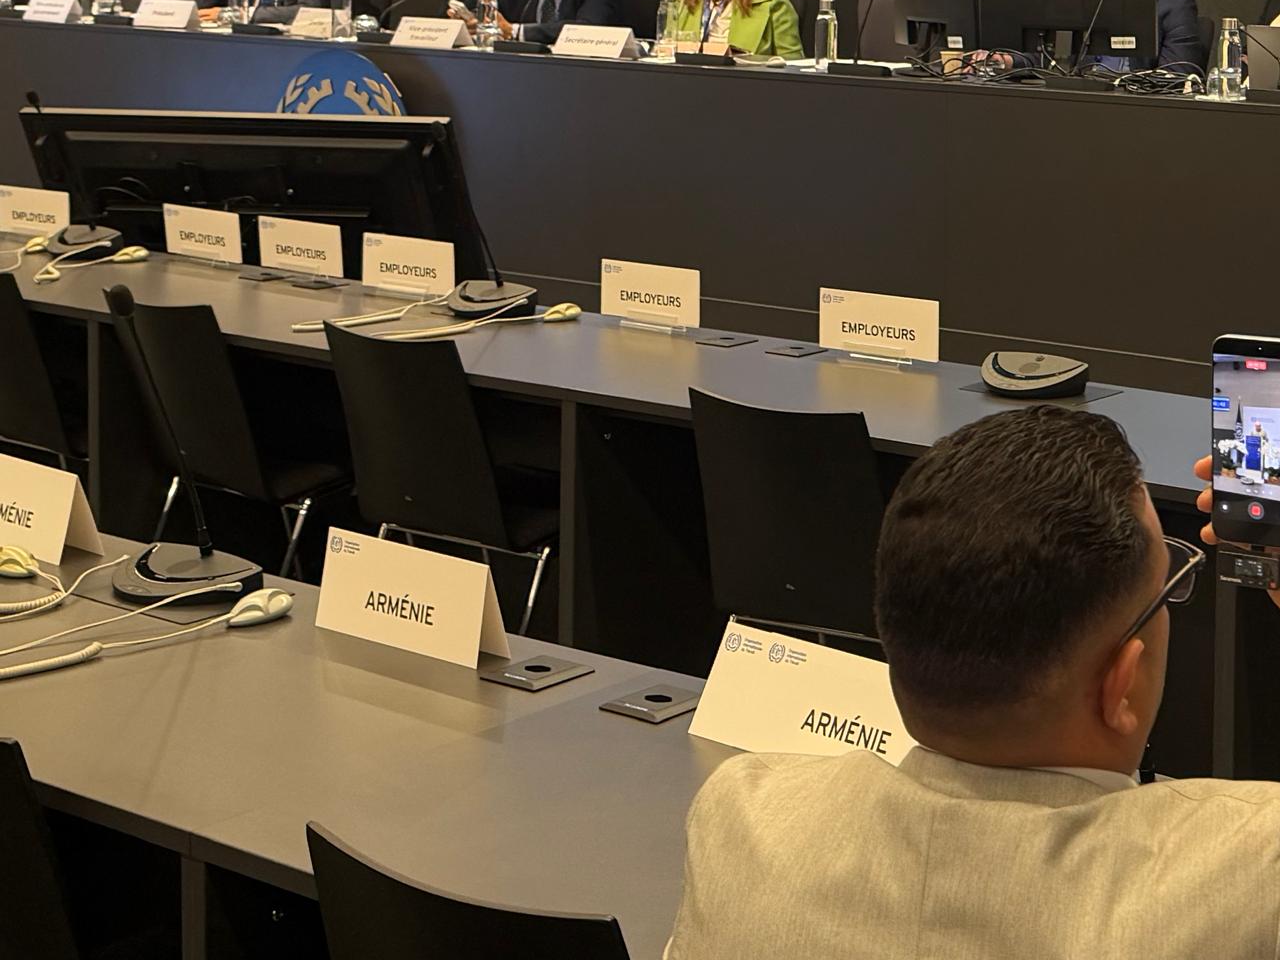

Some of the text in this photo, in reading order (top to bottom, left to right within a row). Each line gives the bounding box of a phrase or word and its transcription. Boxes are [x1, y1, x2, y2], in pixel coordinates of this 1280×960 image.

[12, 210, 56, 224] EMPLOYEURS
[179, 229, 227, 248] EMPLOYEURS
[275, 243, 327, 262] EMPLOYEURS
[379, 261, 438, 280] EMPLOYEURS
[620, 289, 682, 309] EMPLOYEURS
[841, 320, 916, 342] EMPLOYEURS
[364, 588, 436, 627] ARMÉNIE
[800, 708, 892, 755] ARMÉNIE
